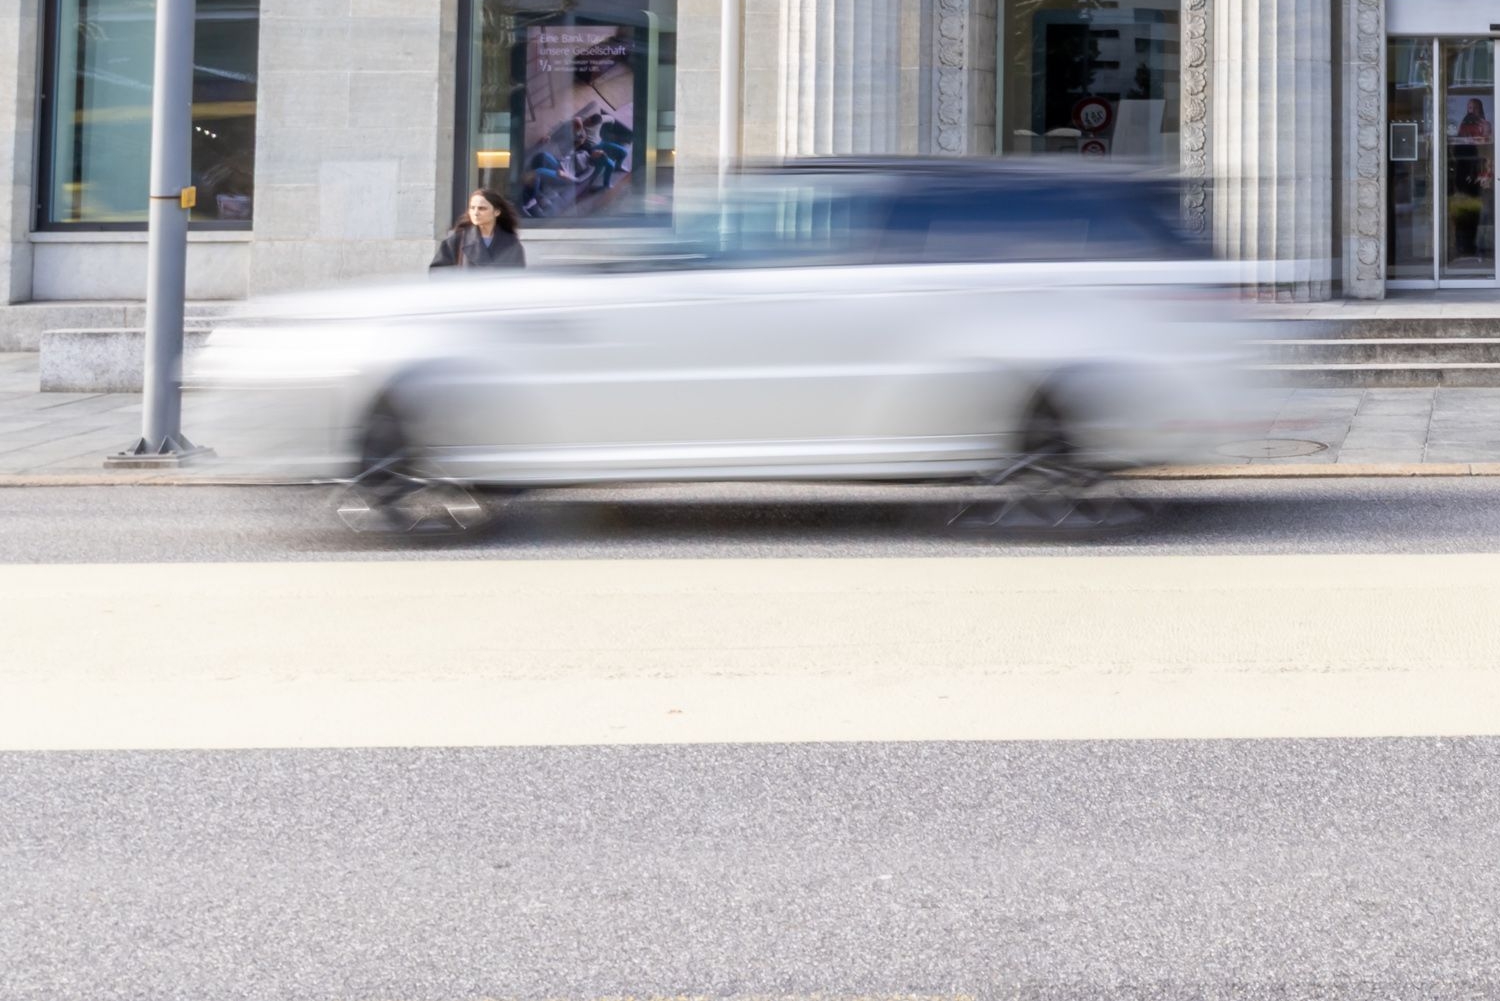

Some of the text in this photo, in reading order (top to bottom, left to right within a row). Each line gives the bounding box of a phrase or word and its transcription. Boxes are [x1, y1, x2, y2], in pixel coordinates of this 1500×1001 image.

[540, 34, 559, 43] Eine
[562, 33, 584, 43] Bank
[540, 45, 626, 56] unsere Gesellschaft
